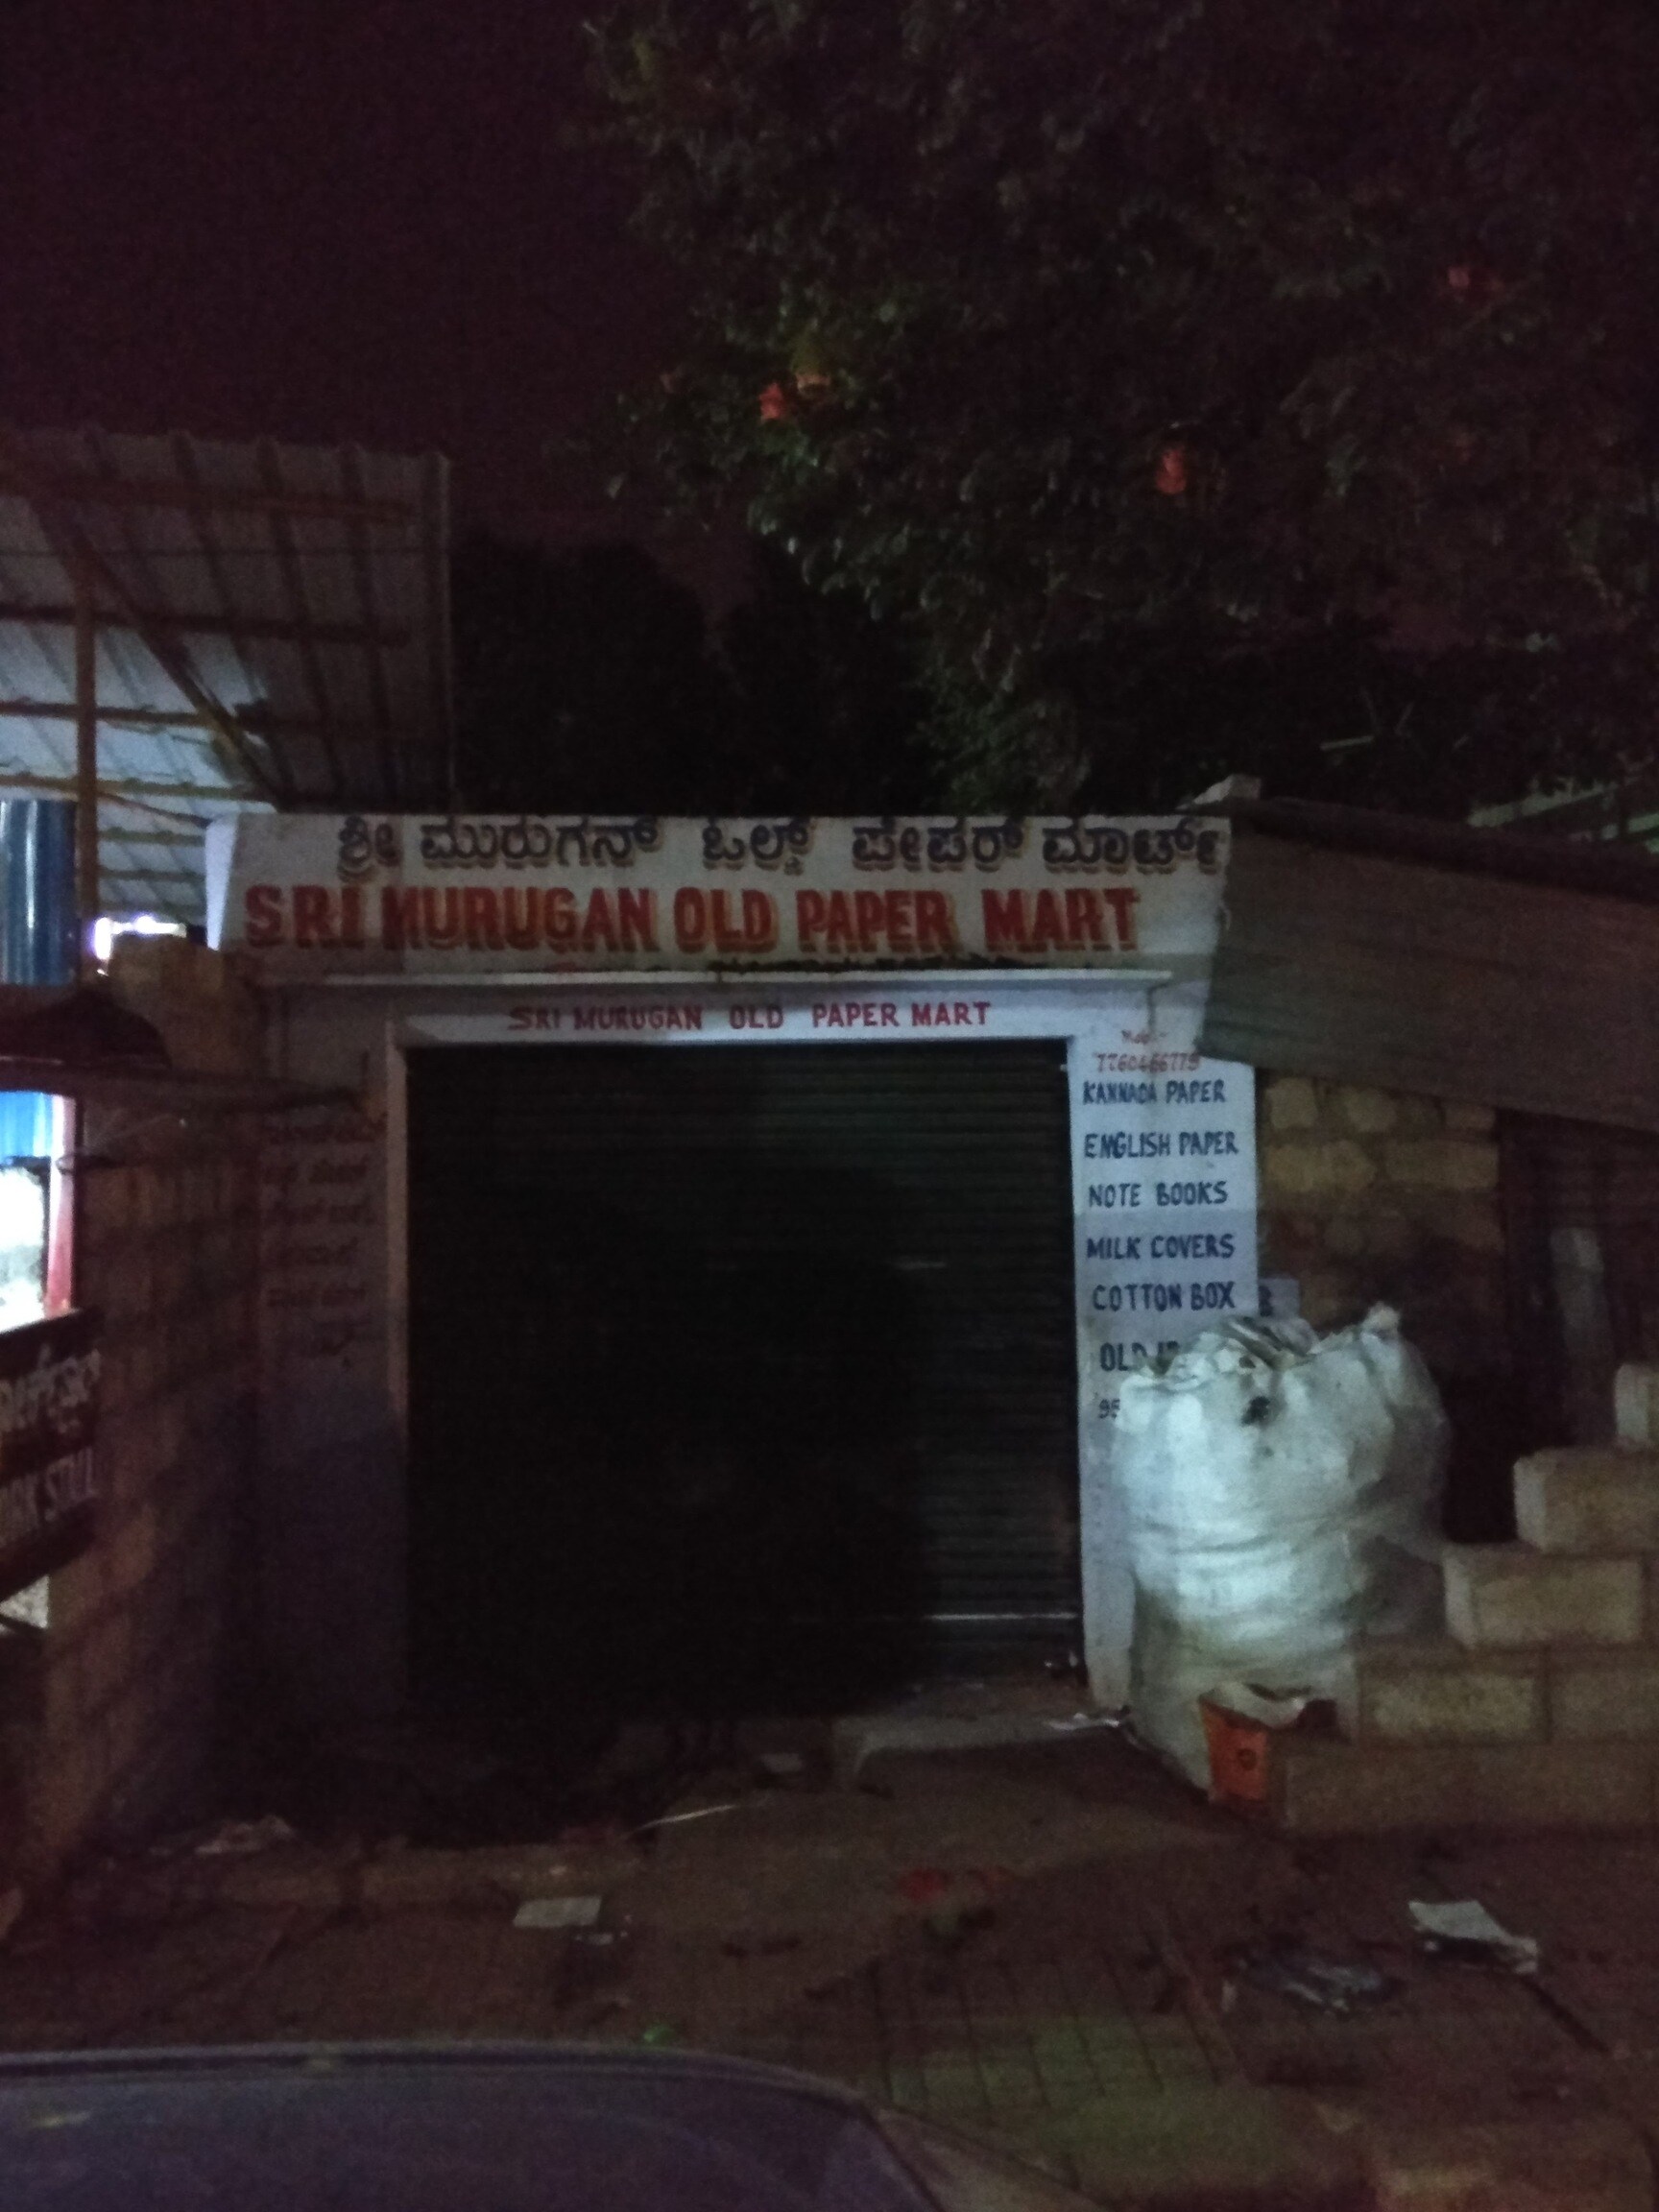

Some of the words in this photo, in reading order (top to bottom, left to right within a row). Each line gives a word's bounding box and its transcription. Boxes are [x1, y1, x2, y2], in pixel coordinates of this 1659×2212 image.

[244, 883, 366, 950] SRI
[381, 885, 660, 952] MURUGAN
[674, 885, 778, 952] OLD
[796, 887, 959, 952] PAPER
[980, 887, 1141, 952] MART
[509, 1005, 561, 1031] SRI
[576, 1005, 703, 1031] MURUGAN
[729, 1003, 784, 1030] OLD
[812, 1002, 900, 1028] PAPER
[911, 1001, 992, 1026] MART
[1082, 1080, 1157, 1104] KANNADA
[1166, 1078, 1227, 1103] PAPER
[1084, 1131, 1171, 1159] ENGLISH
[1178, 1130, 1239, 1156] PAPER
[1088, 1182, 1142, 1209] NOTE
[1156, 1180, 1229, 1206] BOOKS
[1086, 1236, 1142, 1261] MILK
[1151, 1233, 1237, 1260] COVERS
[1093, 1283, 1183, 1312] COTTON
[1190, 1281, 1237, 1311] BOX
